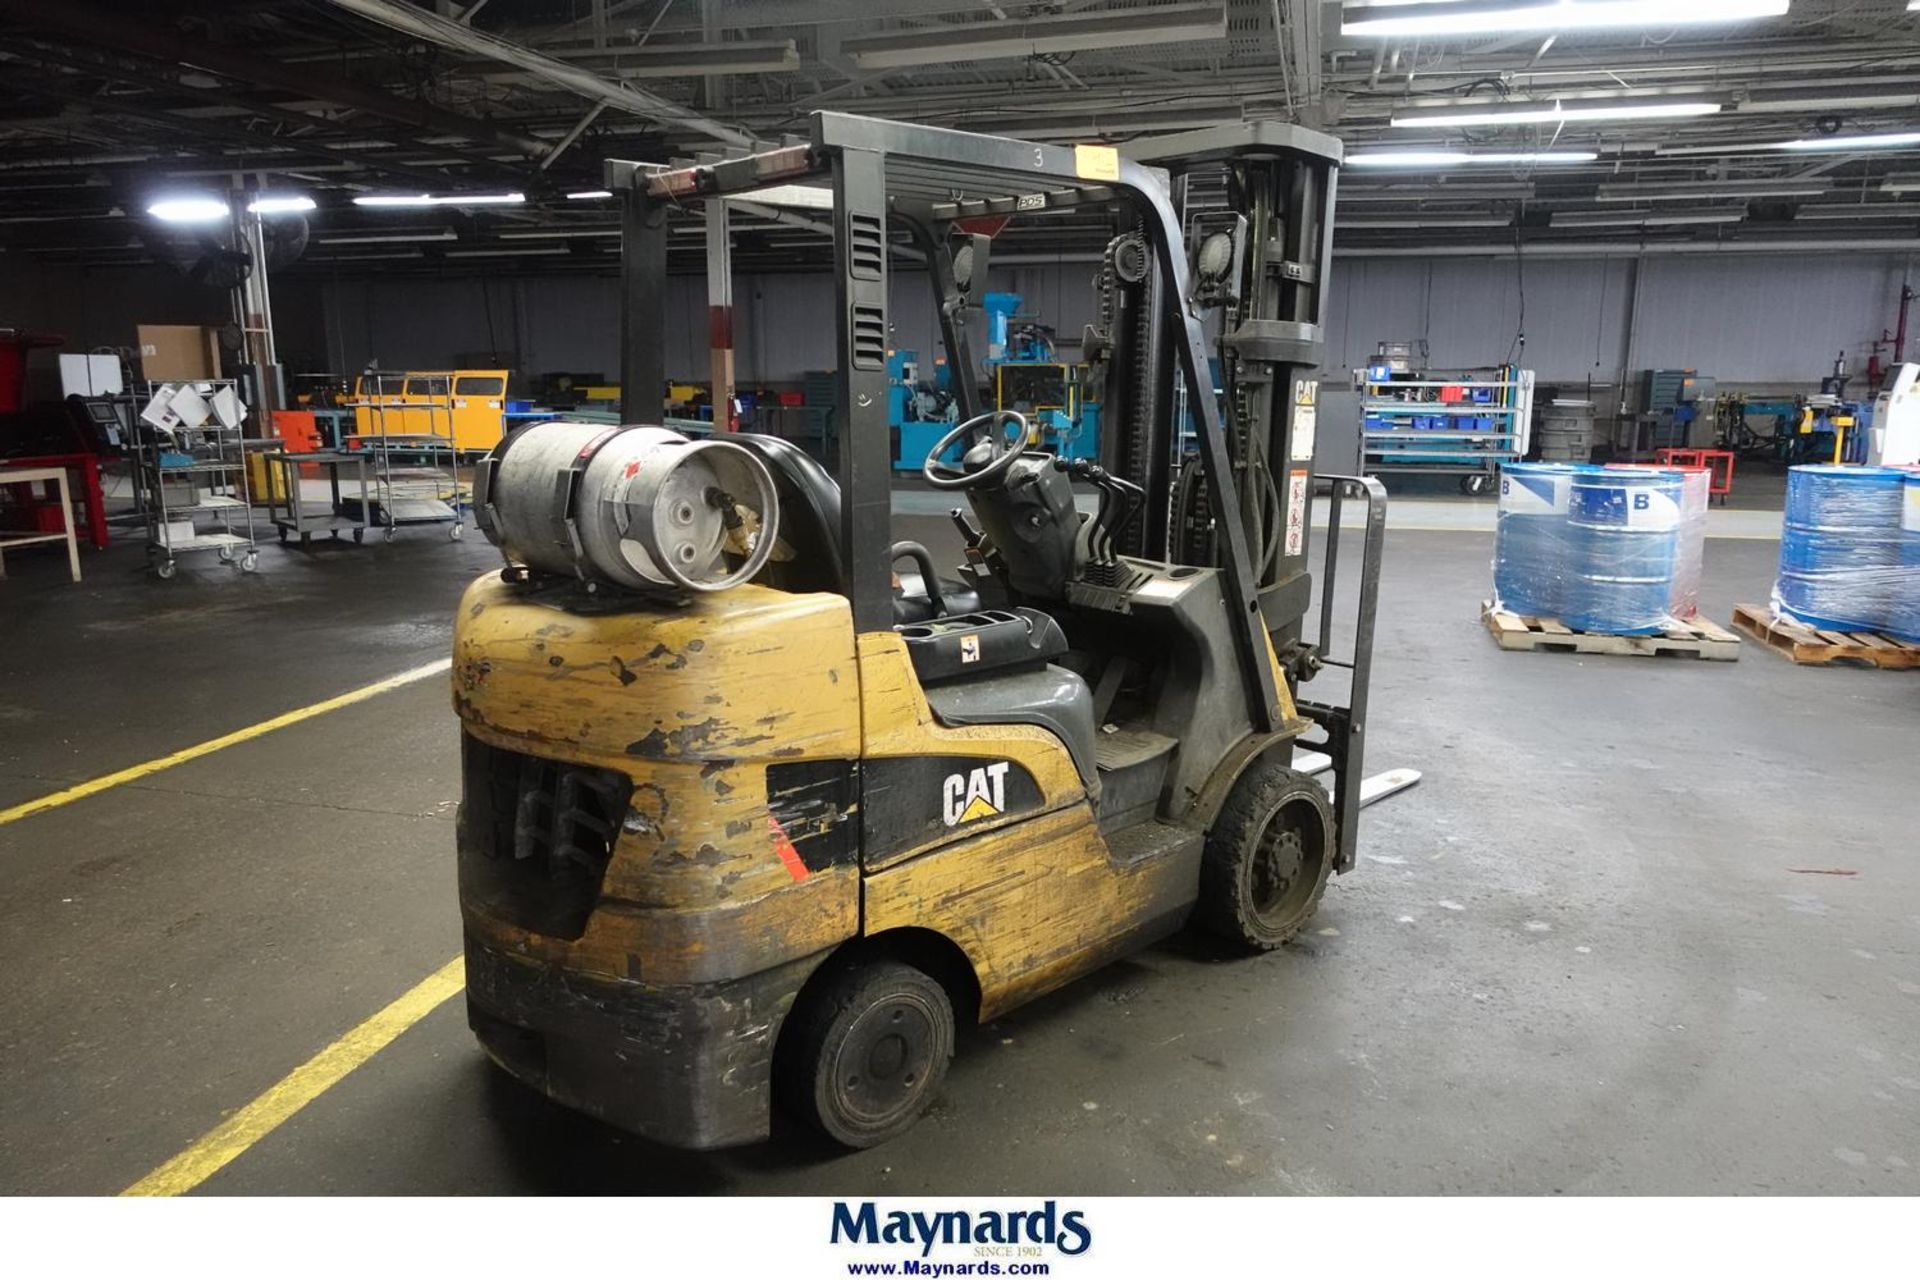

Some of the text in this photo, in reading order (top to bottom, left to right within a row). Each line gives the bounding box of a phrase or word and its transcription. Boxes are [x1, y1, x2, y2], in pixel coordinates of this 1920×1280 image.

[1033, 147, 1043, 168] 3
[1295, 379, 1318, 404] CAT
[1634, 493, 1650, 510] B
[943, 761, 1009, 826] CAT
